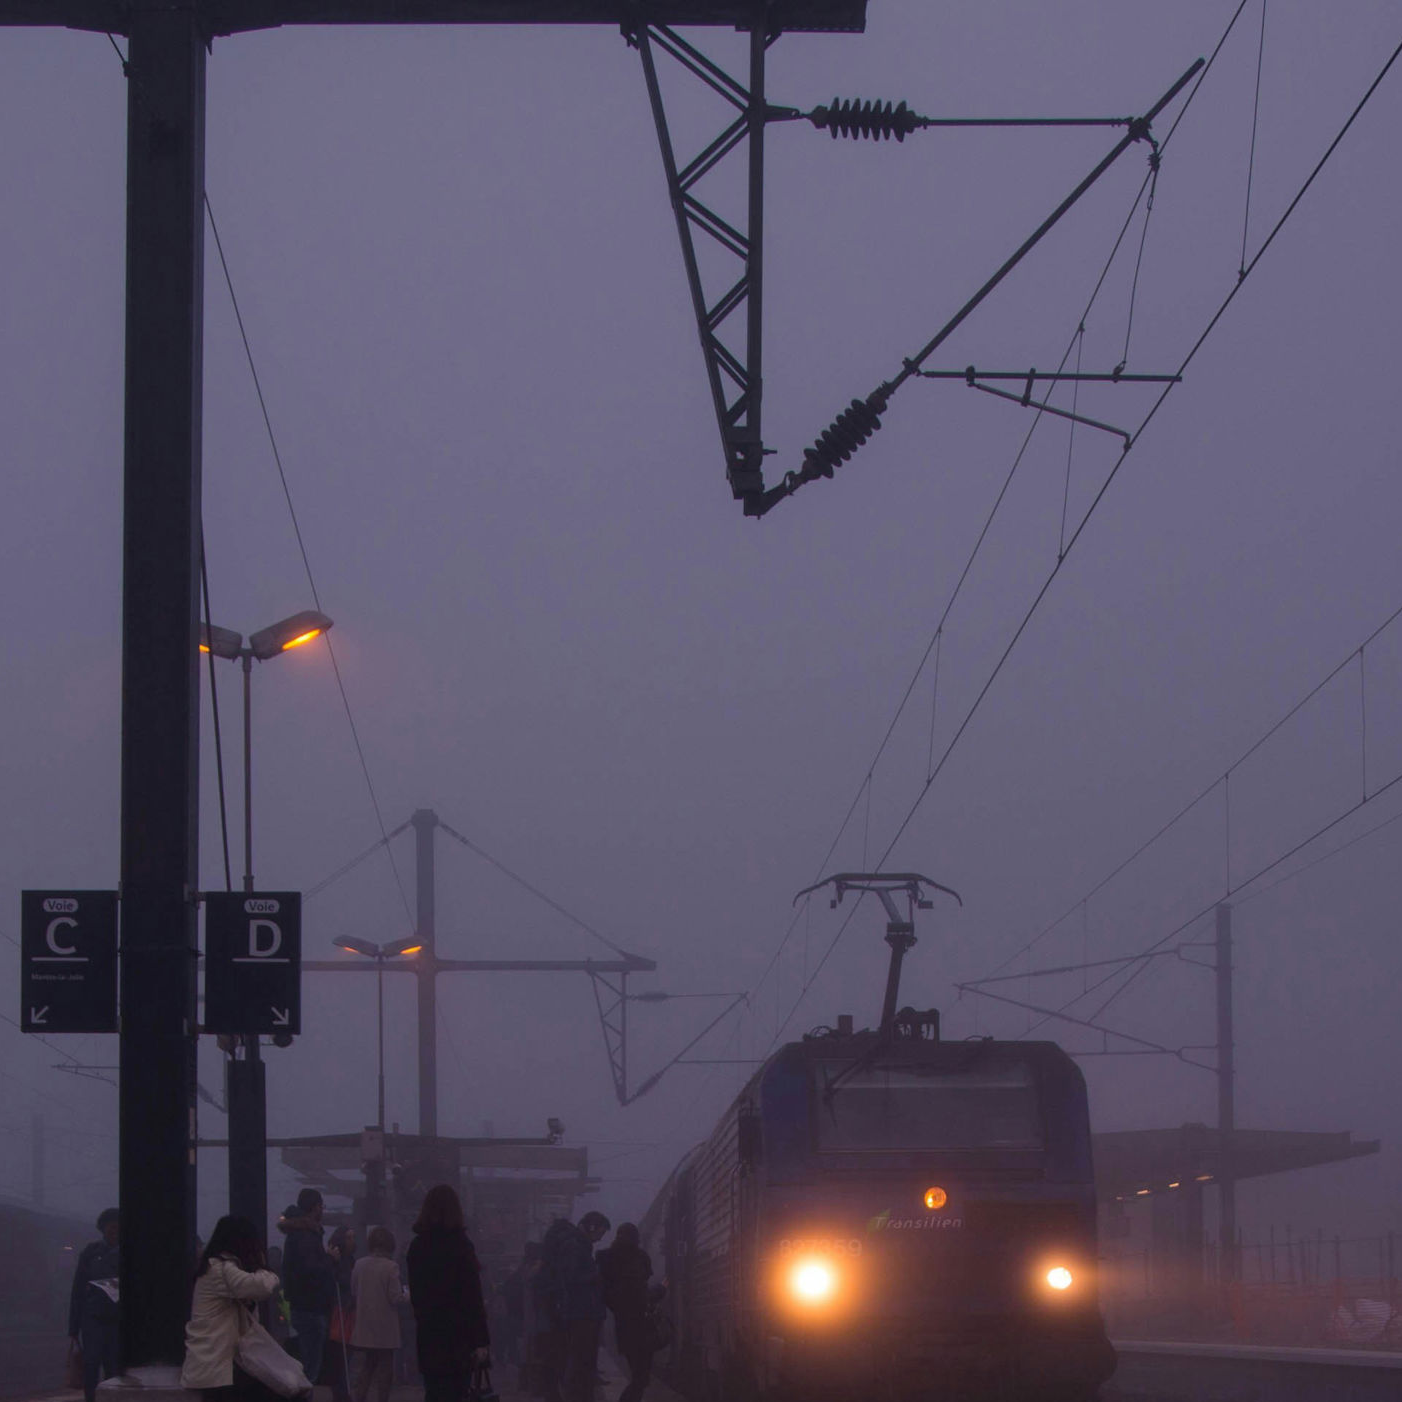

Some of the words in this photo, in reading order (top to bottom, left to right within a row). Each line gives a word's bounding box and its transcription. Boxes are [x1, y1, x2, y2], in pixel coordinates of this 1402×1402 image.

[47, 901, 74, 911] Voie
[249, 901, 275, 911] Voie
[46, 916, 78, 955] C
[248, 919, 282, 957] D
[874, 1216, 963, 1229] Transilien
